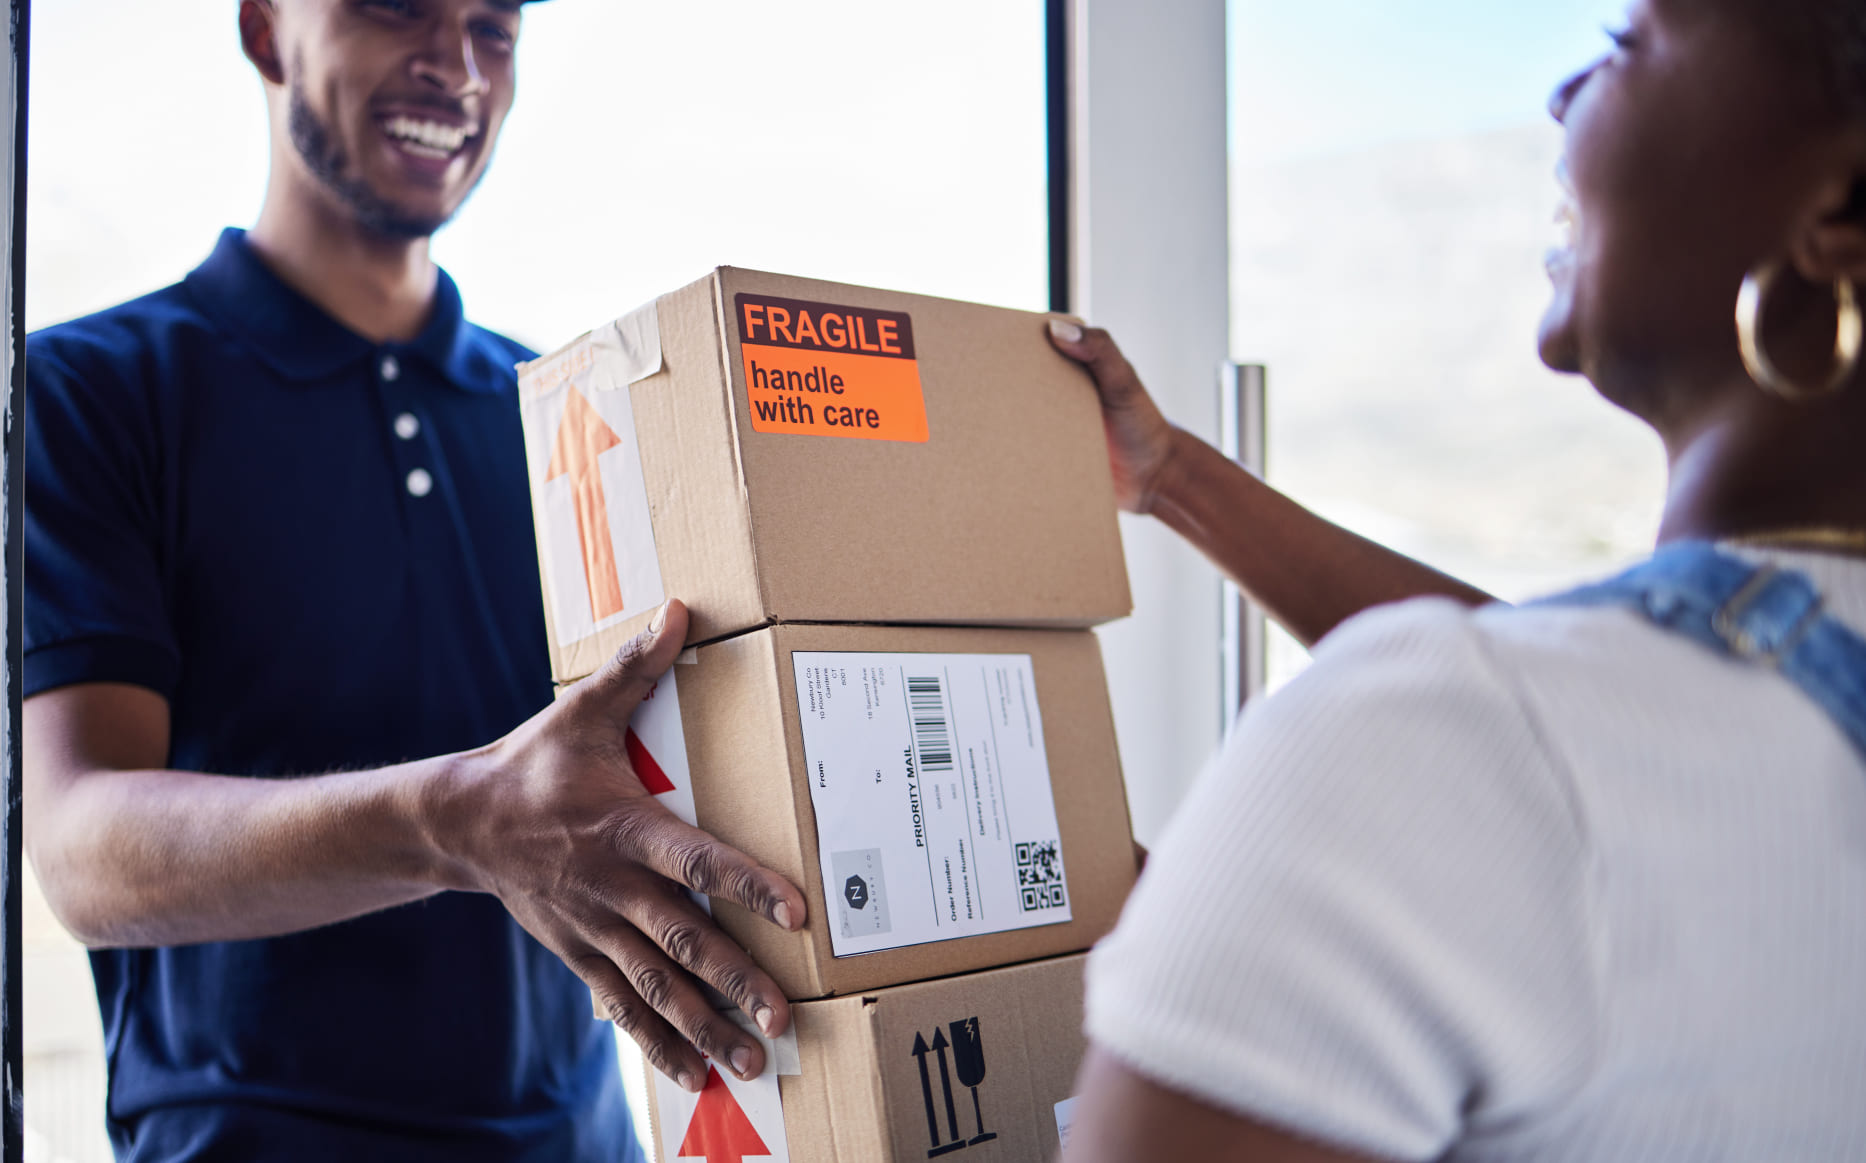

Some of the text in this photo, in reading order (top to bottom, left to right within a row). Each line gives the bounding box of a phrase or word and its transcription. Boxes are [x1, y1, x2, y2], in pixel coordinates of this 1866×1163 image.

[743, 303, 902, 355] FRAGILE
[751, 360, 845, 395] handle
[754, 395, 881, 429] with care
[806, 667, 817, 712] Newbury Co
[814, 667, 822, 689] Street
[823, 667, 831, 699] Gardens
[831, 669, 837, 679] CT
[863, 683, 872, 710] Second
[819, 711, 826, 720] 10
[817, 761, 826, 788] From:
[904, 744, 924, 848] PRIORITY MAIL
[975, 801, 986, 836] Delivery
[850, 885, 862, 900] N
[944, 856, 957, 922] Order Number:
[962, 875, 973, 919] Reference
